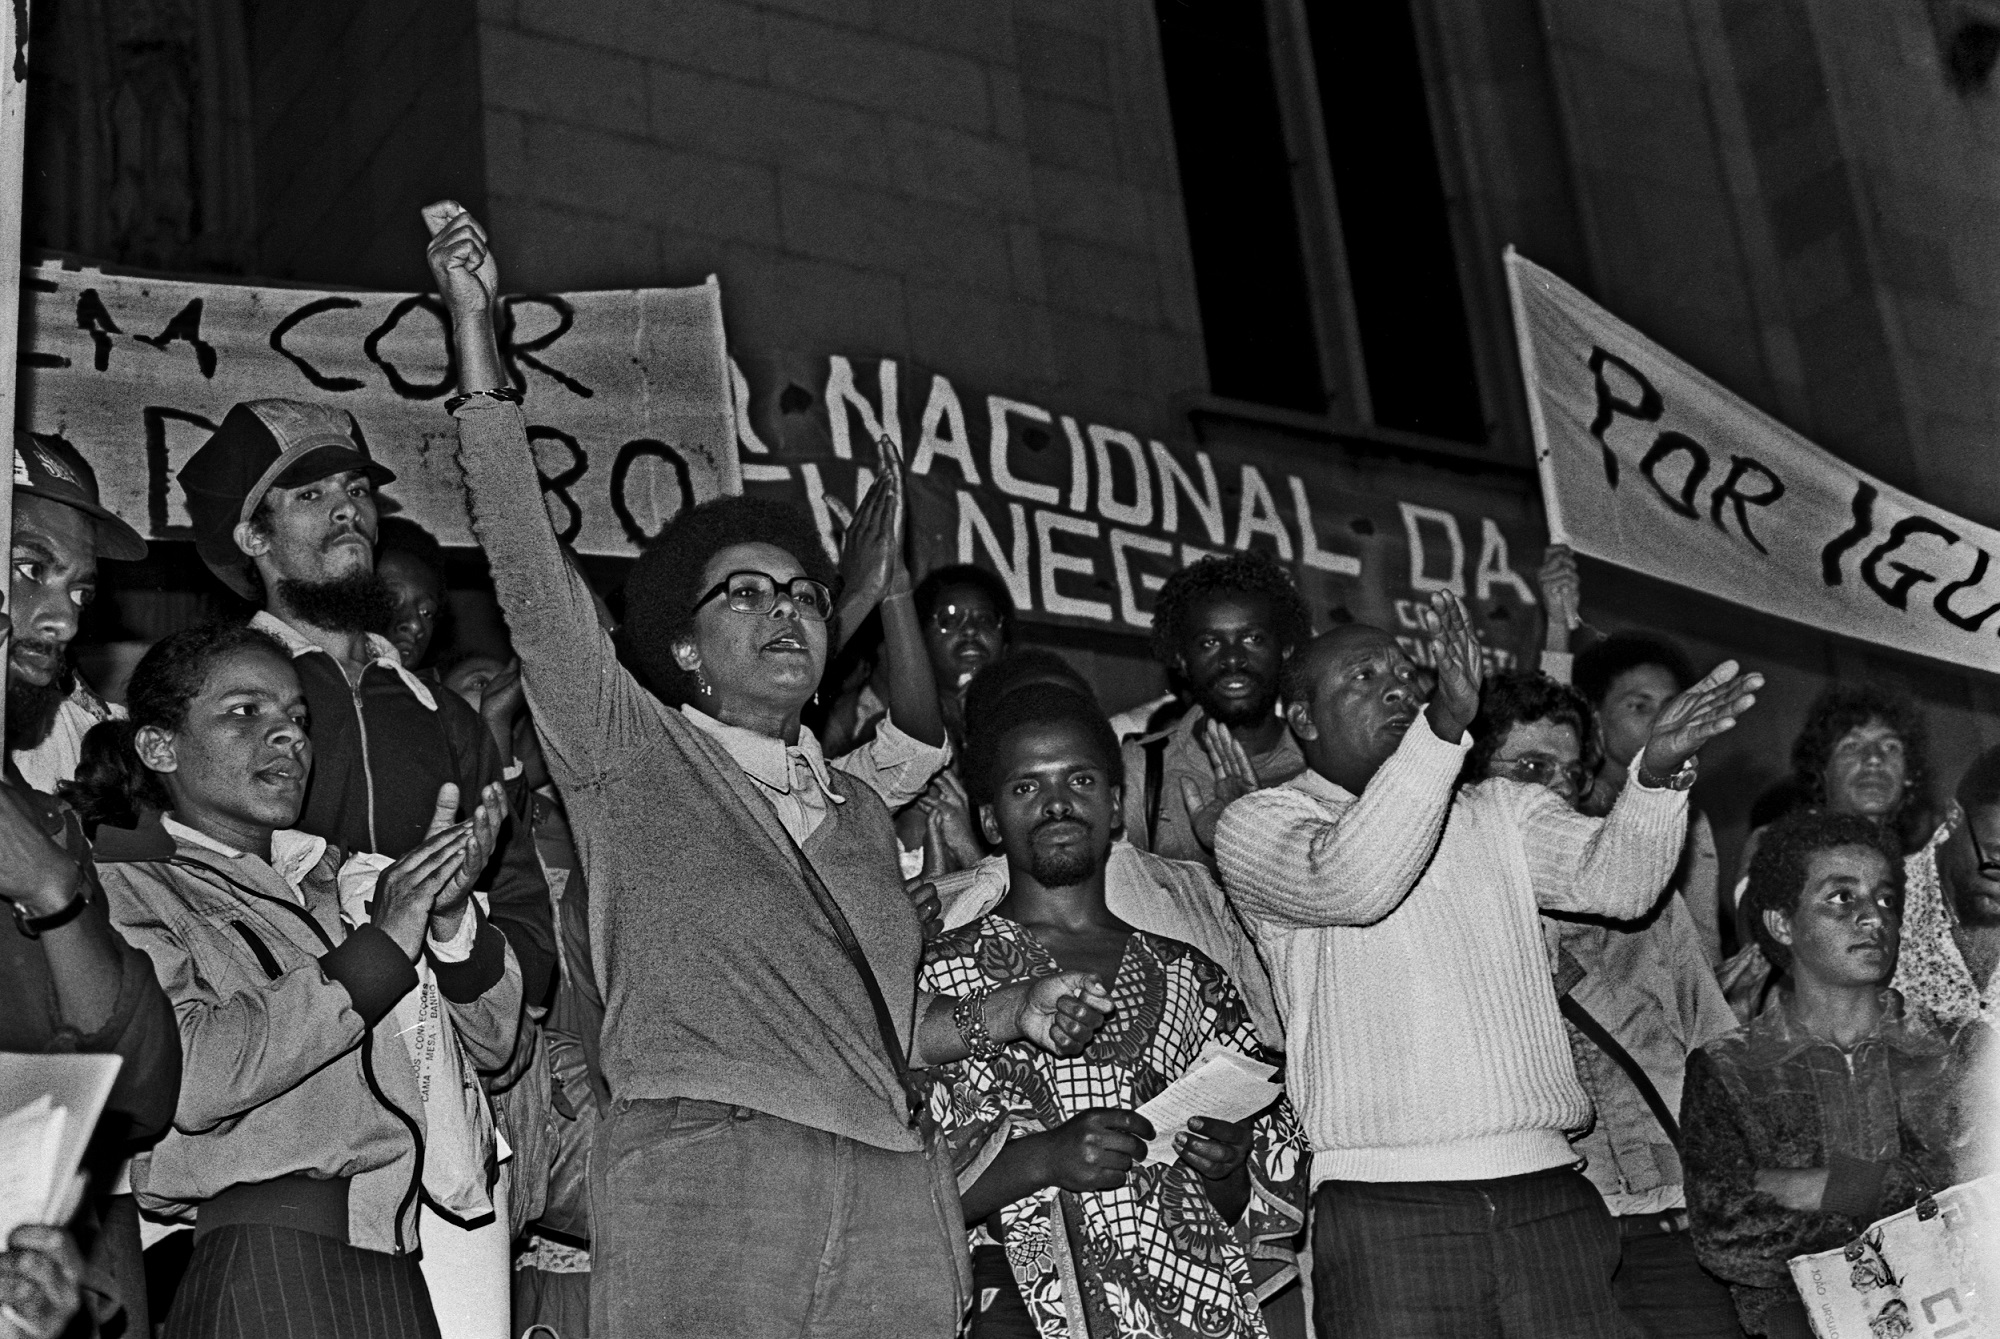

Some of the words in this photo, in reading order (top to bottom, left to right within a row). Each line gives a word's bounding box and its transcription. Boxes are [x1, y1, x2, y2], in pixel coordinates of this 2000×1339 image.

[270, 295, 593, 400] COR
[825, 354, 1361, 577] NACIONAL
[1400, 500, 1537, 605] DA
[1588, 345, 1766, 556] POR
[1821, 481, 2000, 637] IGU
[429, 984, 438, 1019] BANHO
[425, 1033, 436, 1061] MESA
[421, 1074, 431, 1103] CAMA
